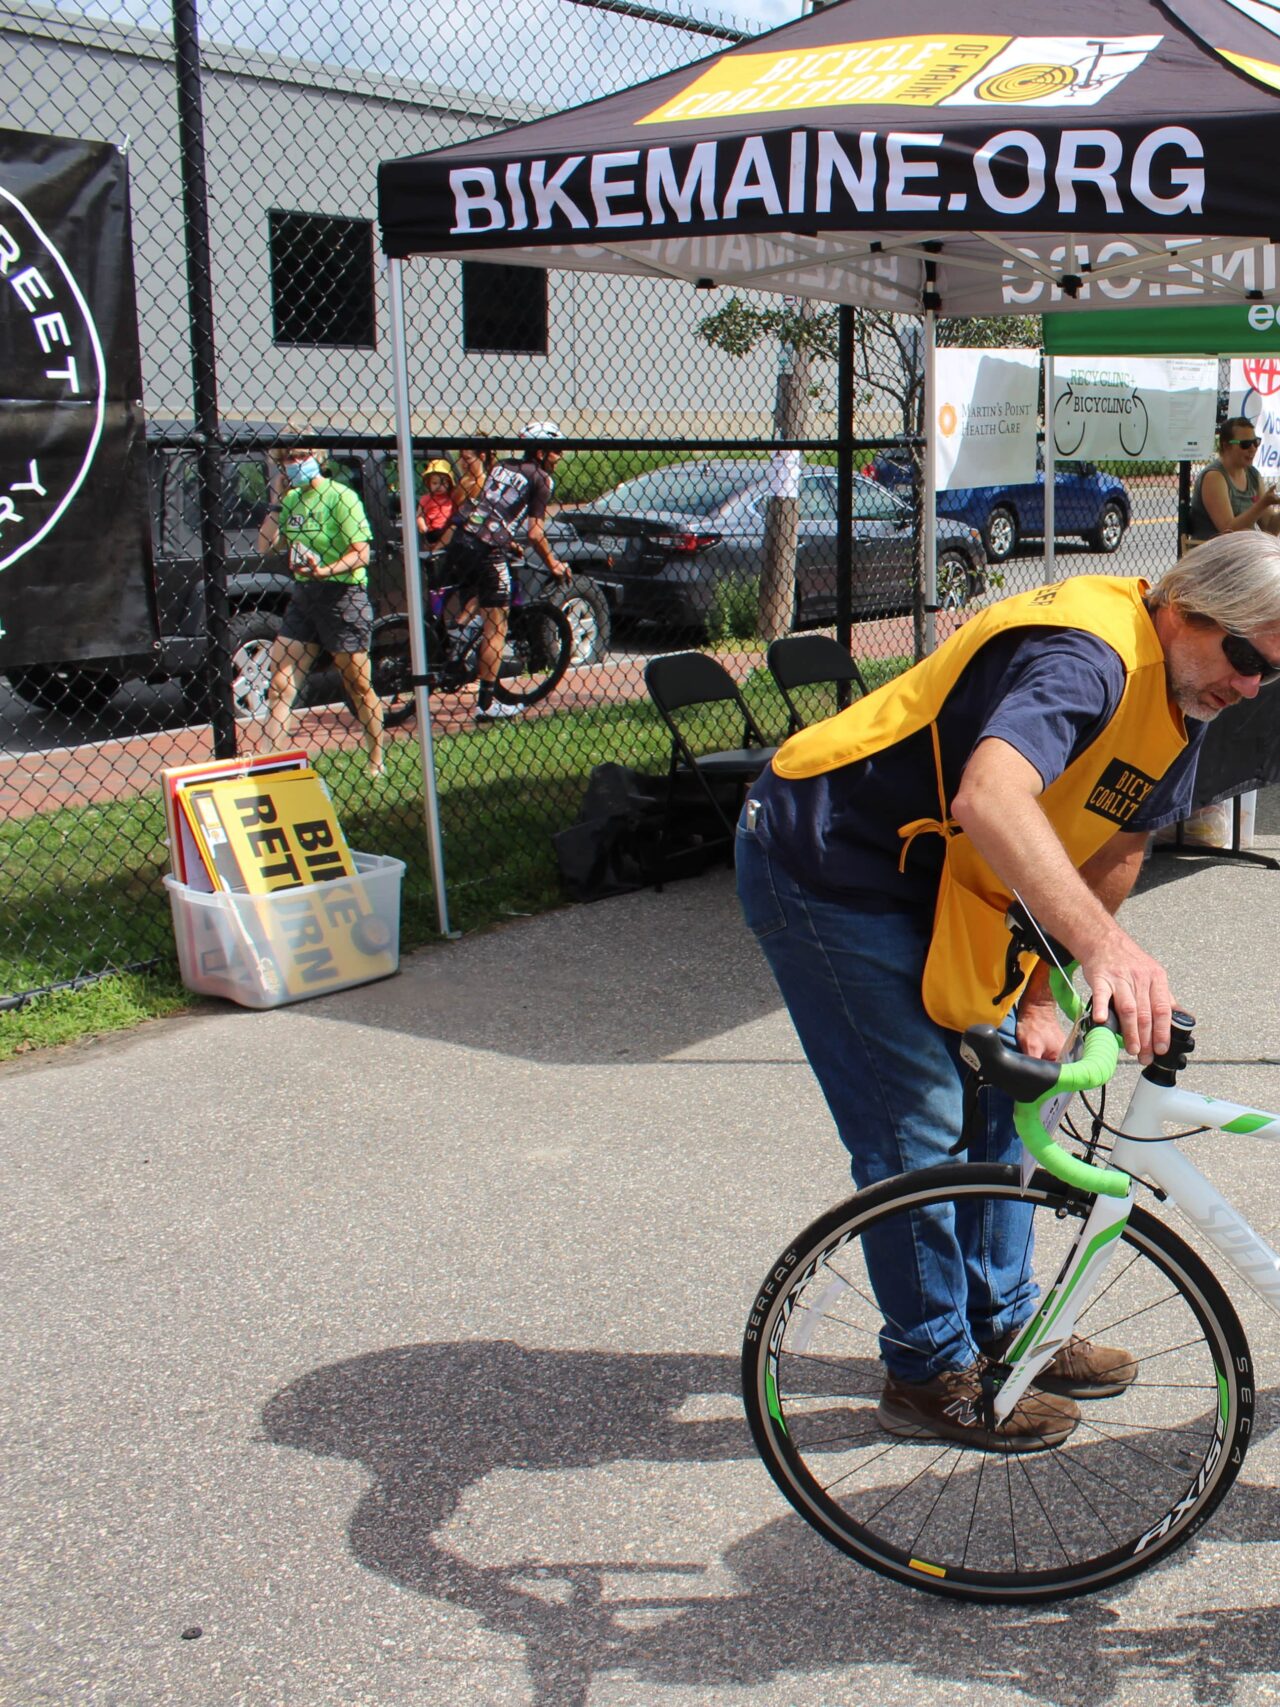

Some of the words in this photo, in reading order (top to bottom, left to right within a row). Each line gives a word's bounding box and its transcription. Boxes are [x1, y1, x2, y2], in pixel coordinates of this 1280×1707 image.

[755, 42, 948, 83] BICYCLE
[954, 43, 988, 63] OF
[663, 73, 910, 118] COALITION
[896, 63, 969, 100] MAINE
[449, 126, 1206, 235] BIKEMAINE.ORG
[0, 224, 80, 393] REET
[1073, 396, 1133, 414] BICYCLING
[1089, 786, 1140, 820] COALIT
[1115, 770, 1153, 801] BICY
[233, 794, 339, 984] RETURN
[292, 819, 357, 928] BIKE
[747, 1249, 797, 1342] SERFAS
[1232, 1356, 1252, 1465] SECA
